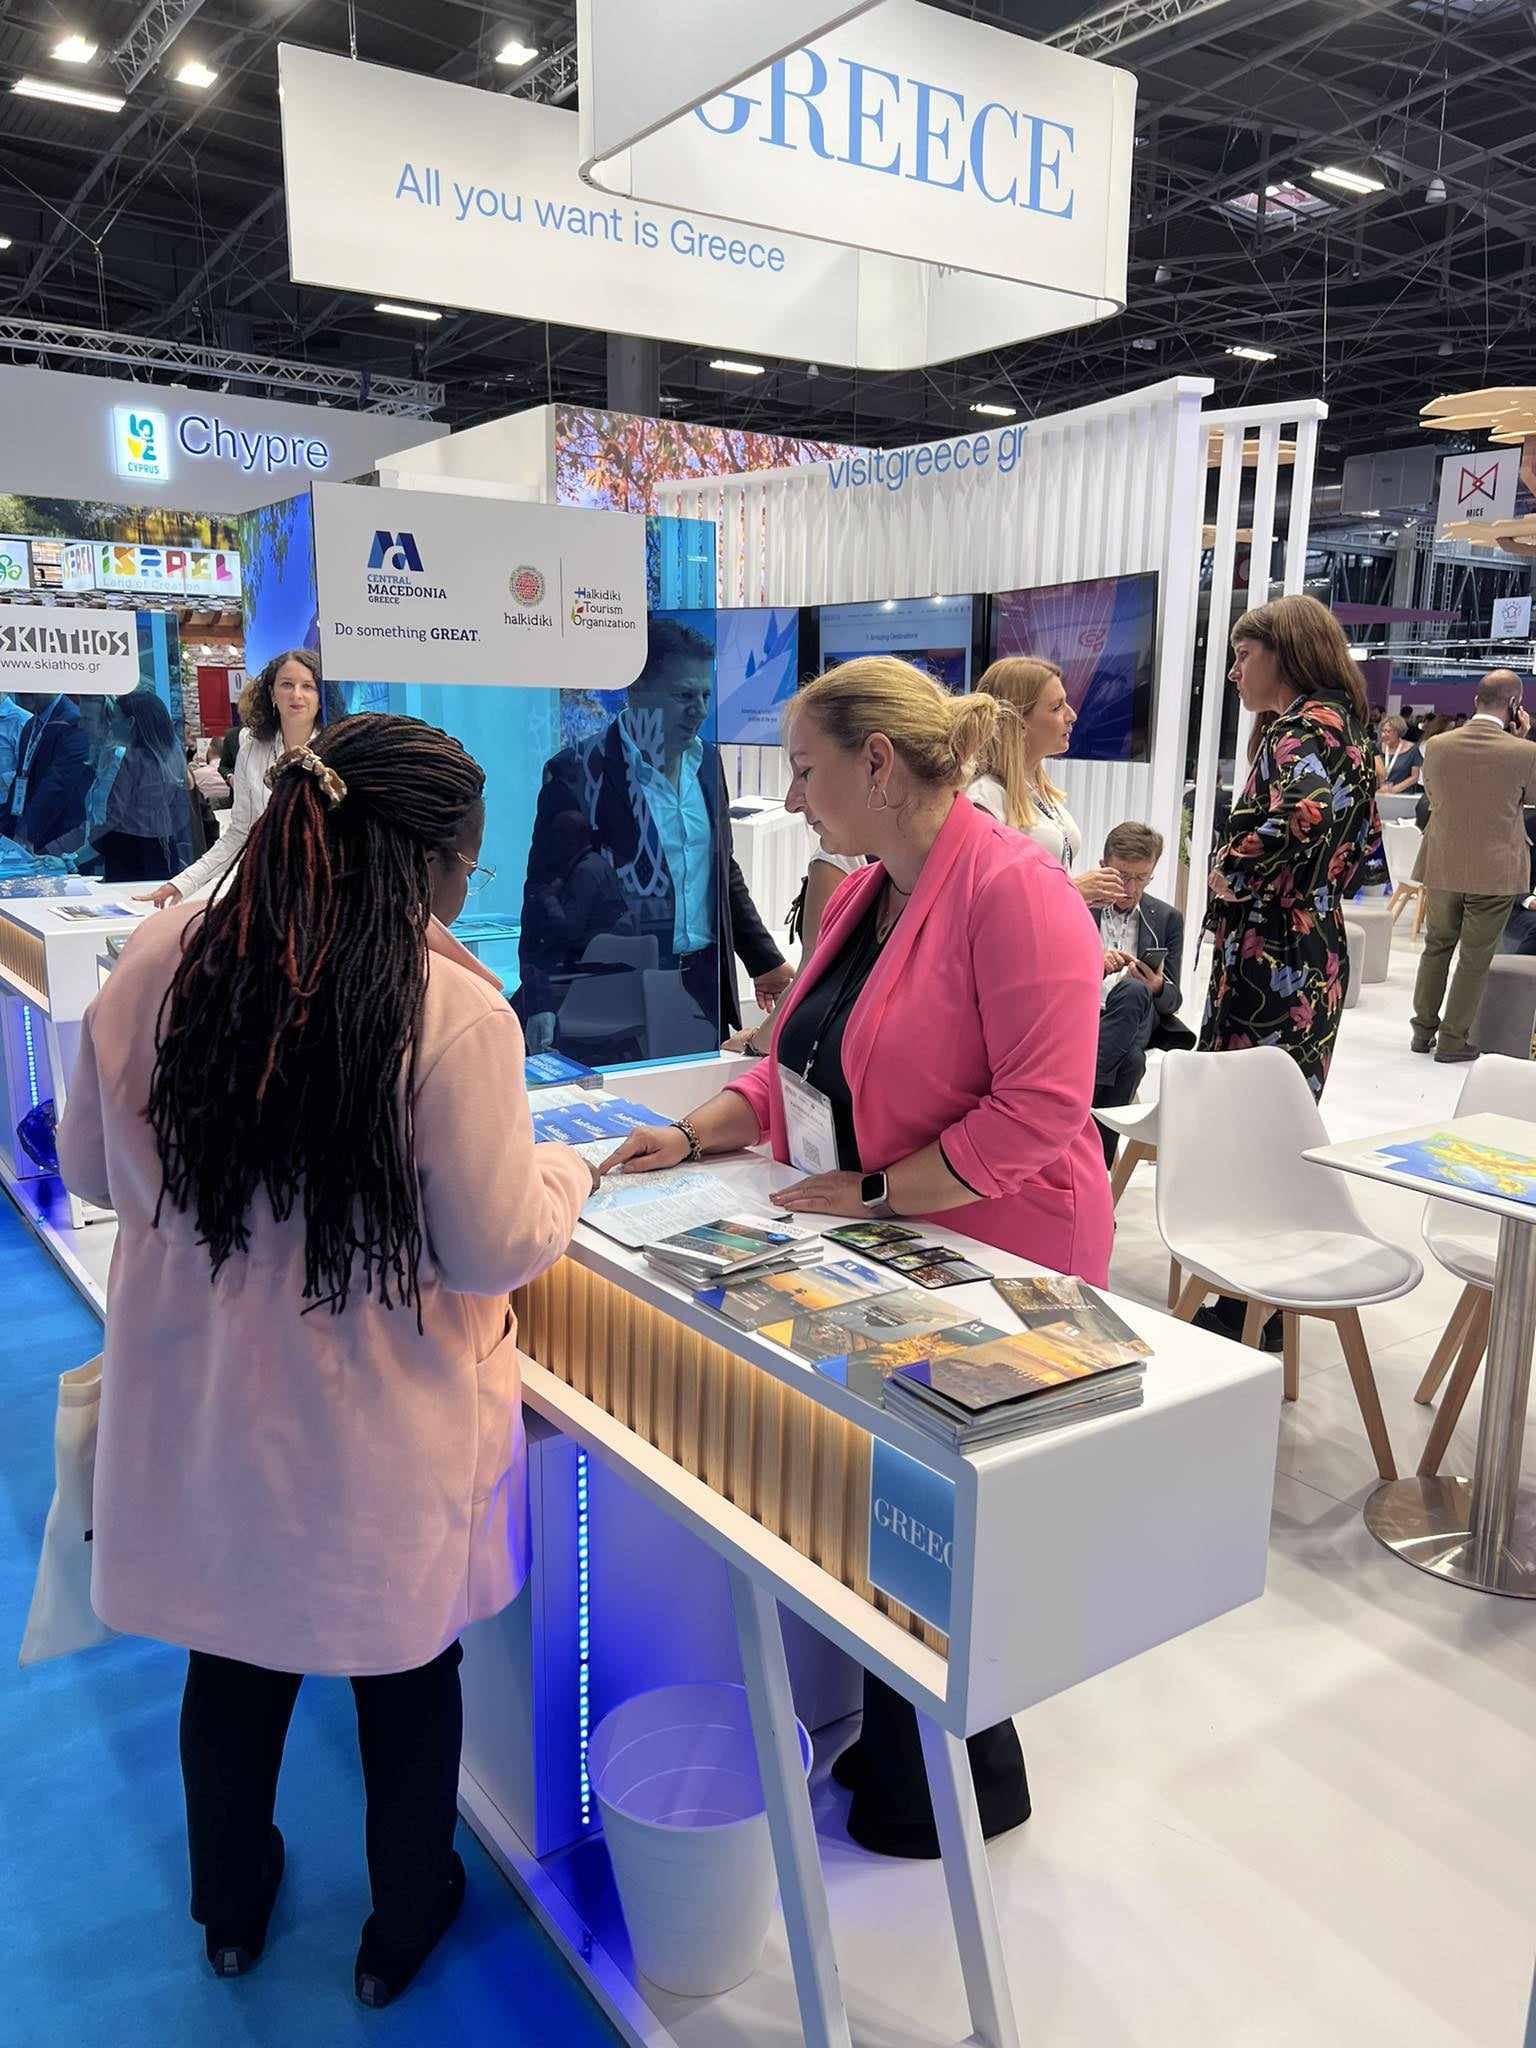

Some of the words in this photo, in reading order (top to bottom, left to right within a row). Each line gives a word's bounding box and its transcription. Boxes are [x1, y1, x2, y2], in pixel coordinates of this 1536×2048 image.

[396, 163, 440, 206] All
[453, 183, 522, 222] you
[534, 199, 623, 242] want
[634, 211, 659, 248] is
[670, 219, 785, 272] Greece
[179, 416, 329, 472] Chypre
[828, 435, 990, 491] visitgreece
[997, 425, 1029, 473] gr
[128, 462, 160, 474] CYPRUS
[367, 574, 412, 585] CENTRAL
[367, 584, 447, 599] MACEDONIA
[574, 587, 622, 601] Halkidiki
[368, 595, 401, 604] GREECE
[584, 601, 623, 615] Tourism
[504, 613, 553, 627] halkidiki
[573, 615, 636, 629] Organization
[335, 623, 353, 635] Do
[357, 626, 427, 643] something
[430, 628, 481, 642] GREAT.
[0, 626, 129, 656] SKIATHOS
[1, 659, 101, 674] www.skiathos.gr
